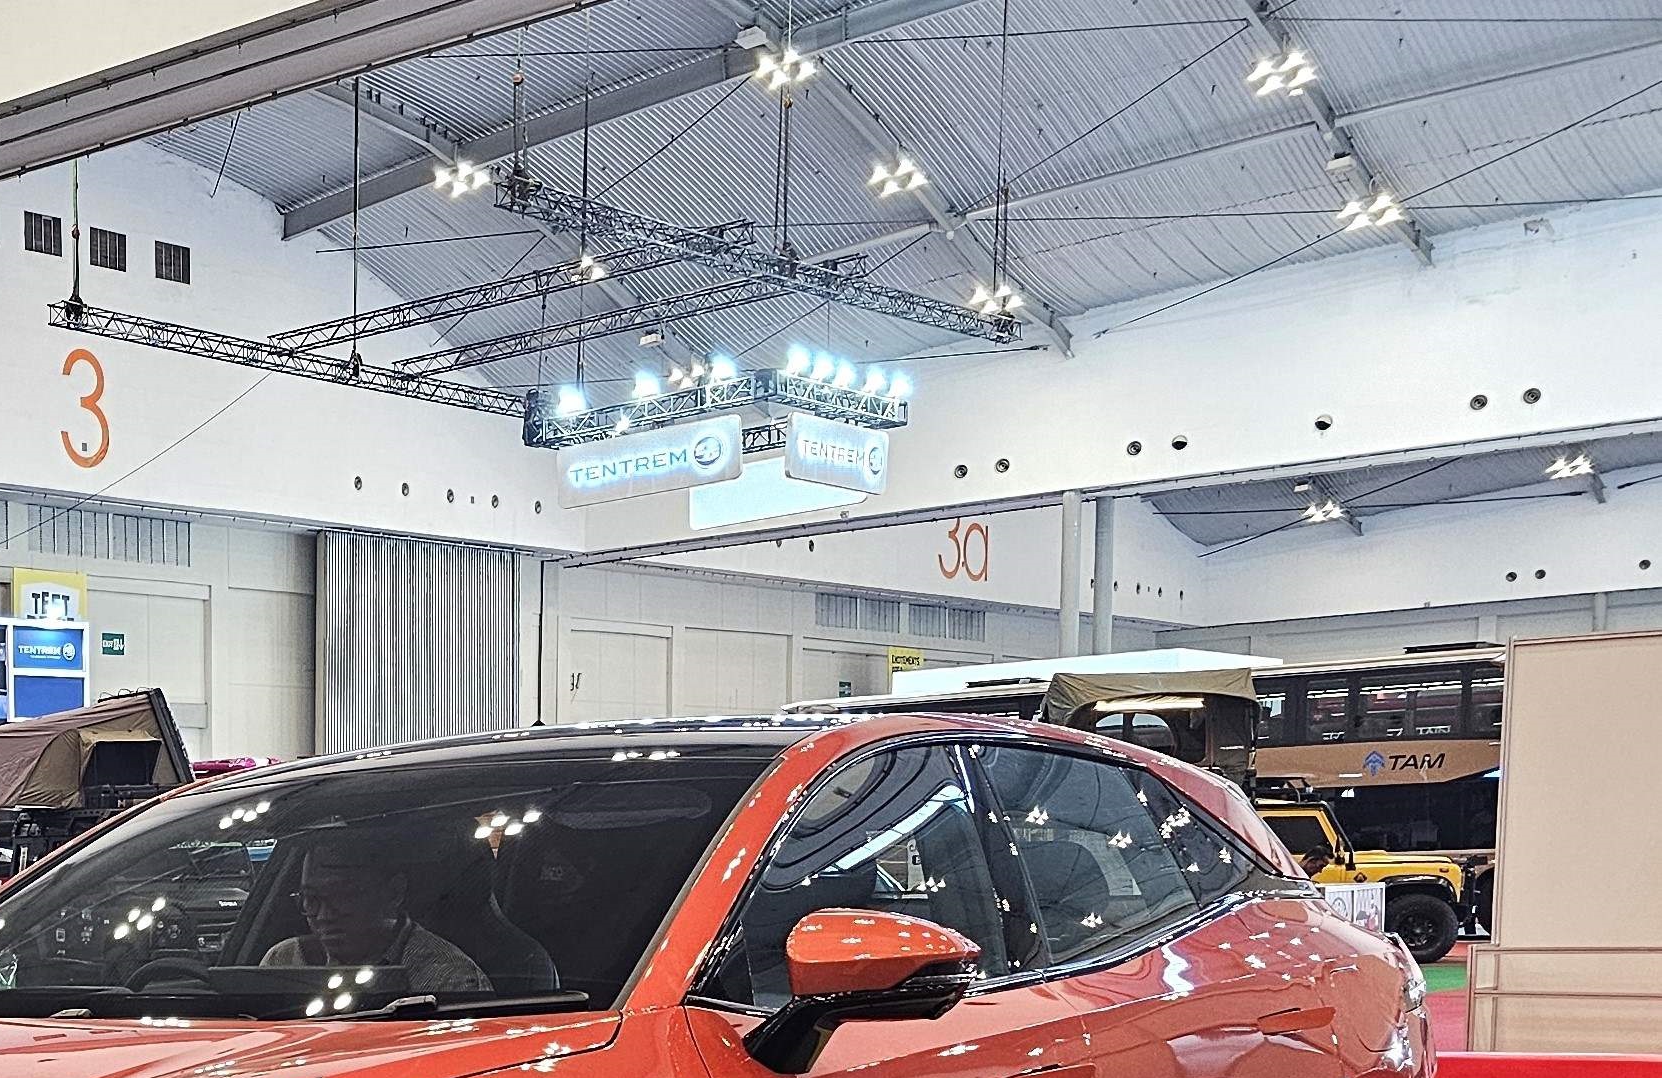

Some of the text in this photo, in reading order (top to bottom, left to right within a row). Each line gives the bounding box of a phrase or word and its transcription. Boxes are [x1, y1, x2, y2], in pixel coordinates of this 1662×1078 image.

[61, 349, 110, 468] 3
[570, 448, 687, 483] TENTREM
[803, 439, 865, 467] TENTREM
[18, 645, 62, 656] TENTREM
[1388, 753, 1446, 771] TAM
